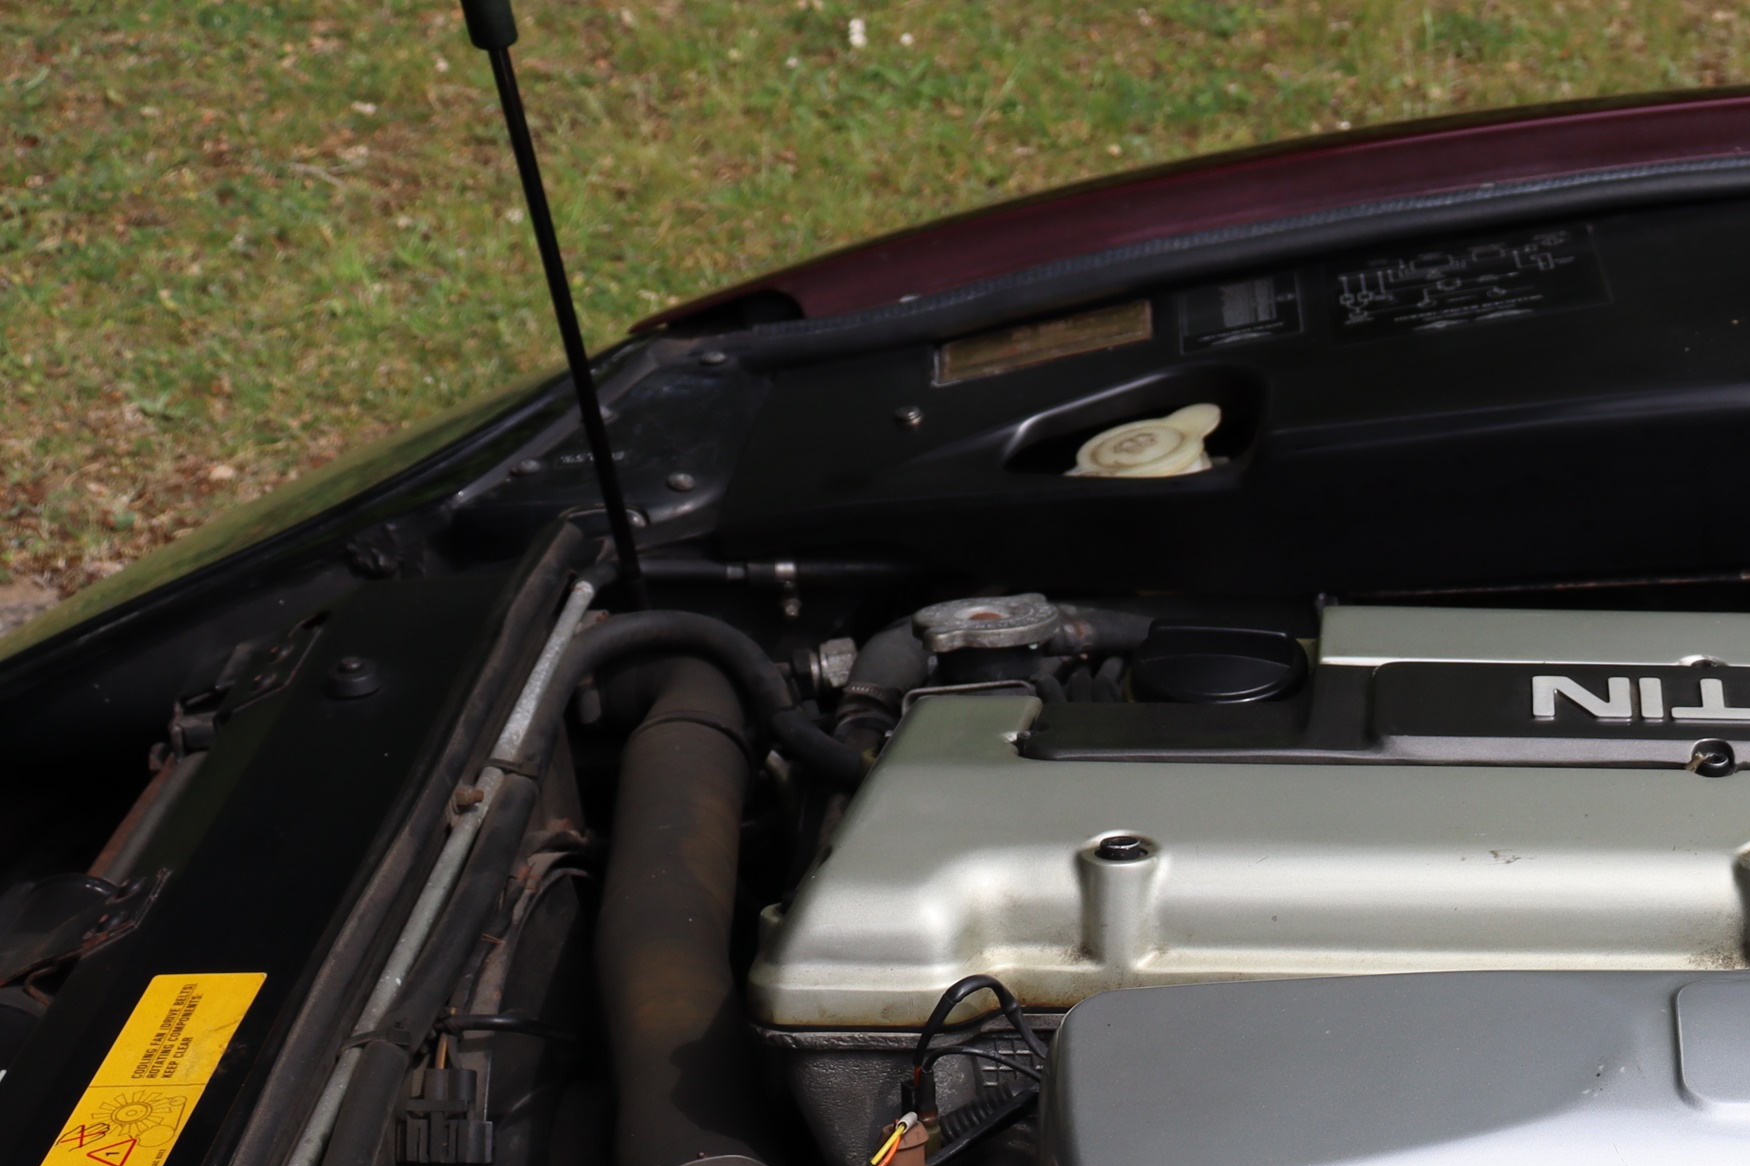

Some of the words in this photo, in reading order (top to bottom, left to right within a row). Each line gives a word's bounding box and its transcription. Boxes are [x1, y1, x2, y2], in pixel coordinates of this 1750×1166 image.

[131, 1048, 158, 1079] COOLING
[150, 1032, 166, 1047] FAN
[146, 1043, 175, 1079] ROTATING
[161, 1061, 179, 1079] KEEP
[173, 1036, 194, 1059] CLEAR
